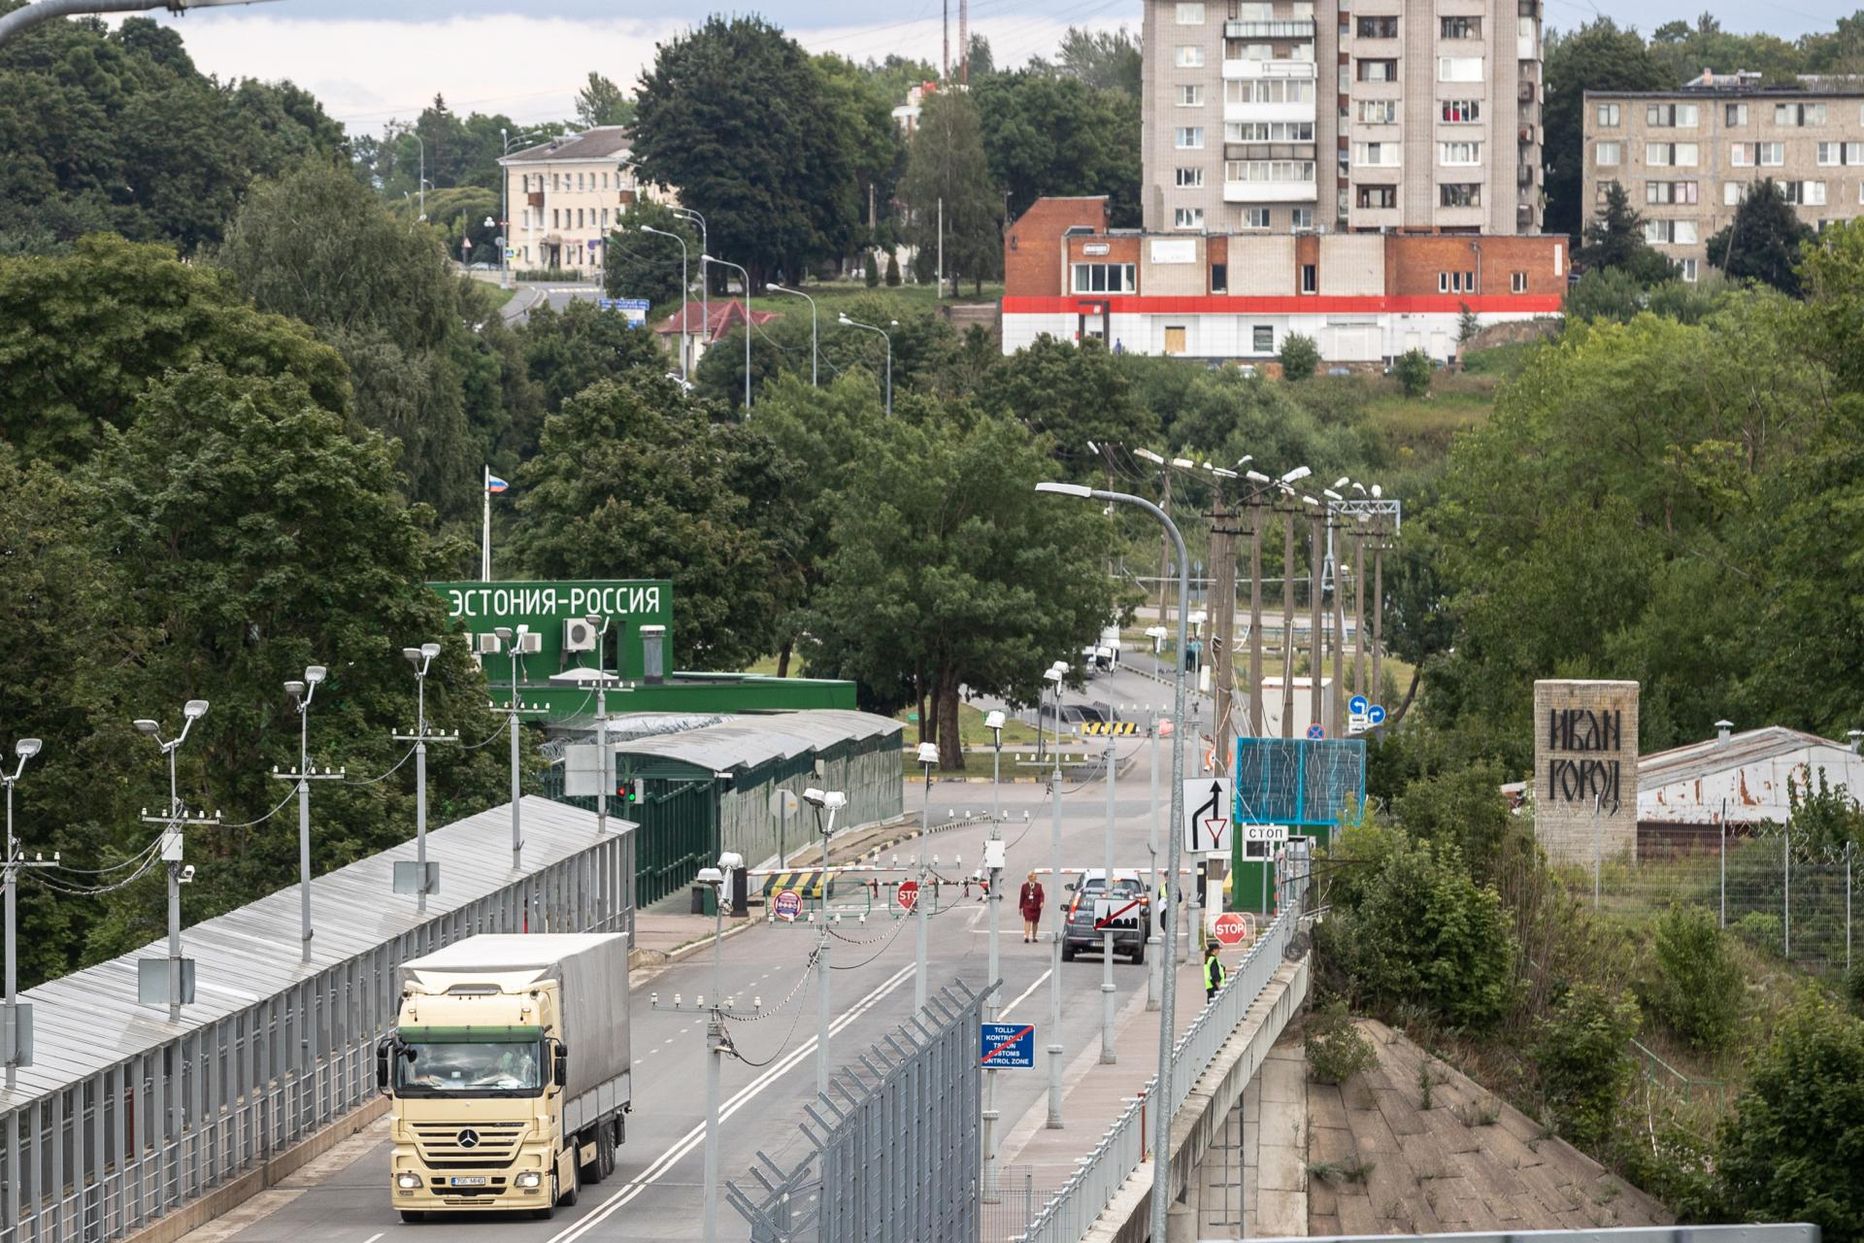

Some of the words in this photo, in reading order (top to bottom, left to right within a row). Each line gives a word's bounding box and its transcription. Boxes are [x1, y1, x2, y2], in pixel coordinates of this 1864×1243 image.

[449, 587, 660, 616] ЭСТОНИЯ-РОССИЯ
[1550, 709, 1620, 751] ИВАН
[1550, 759, 1620, 817] ГОРОД
[1249, 828, 1283, 839] СТОП
[899, 890, 919, 900] STO
[1216, 923, 1244, 935] STOP
